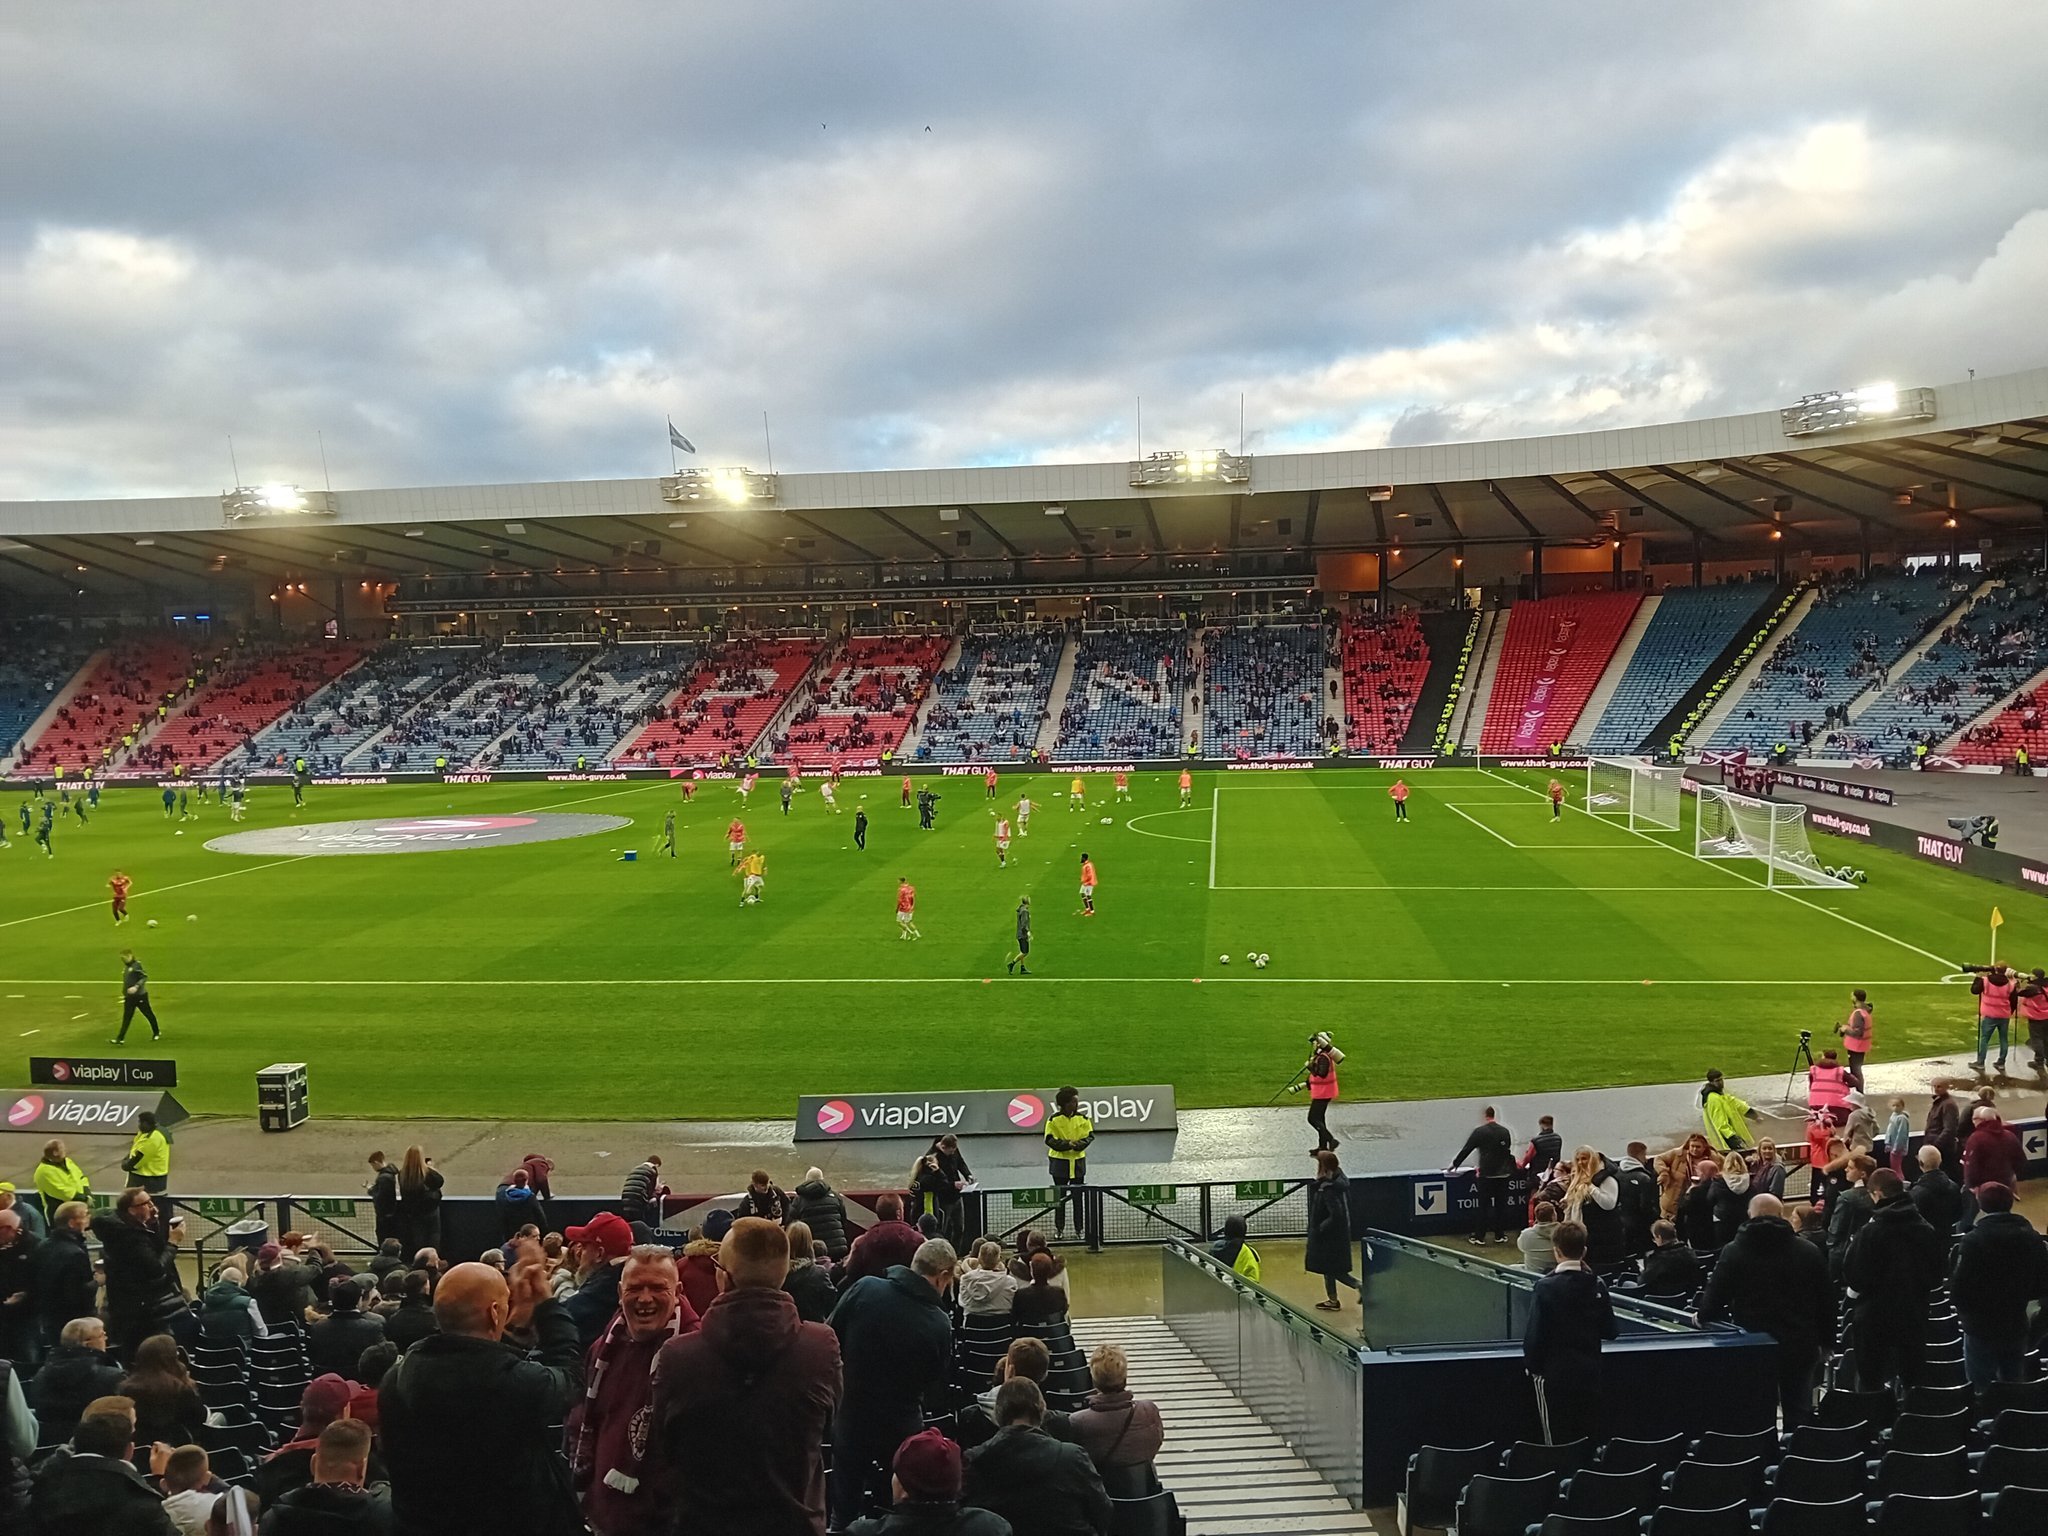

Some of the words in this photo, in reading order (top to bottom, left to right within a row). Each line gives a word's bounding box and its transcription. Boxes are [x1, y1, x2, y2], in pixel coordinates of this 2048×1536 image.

[1051, 764, 1135, 773] www.that-guy.co.uk
[1226, 761, 1314, 771] www.that-guy.co.uk
[1378, 760, 1410, 769] THAT
[1411, 759, 1435, 769] GUY
[800, 769, 882, 777] www.th-guy.co.uk
[942, 766, 971, 776] THAT
[311, 776, 387, 785] www.that-guy.co.uk
[443, 775, 471, 784] THAT
[471, 774, 491, 784] GUY
[547, 773, 627, 781] www.that-guy.co.uk
[55, 781, 84, 790] THAT
[1812, 813, 1871, 837] www.that-guy.co.uk
[297, 833, 502, 842] viaplay
[1917, 836, 1943, 859] THAT
[1943, 844, 1964, 864] GUY
[72, 1064, 120, 1082] viaplay
[131, 1068, 154, 1081] Cup
[47, 1099, 140, 1127] viaplay
[1050, 1095, 1154, 1123] vaplay
[861, 1101, 965, 1130] viaplay
